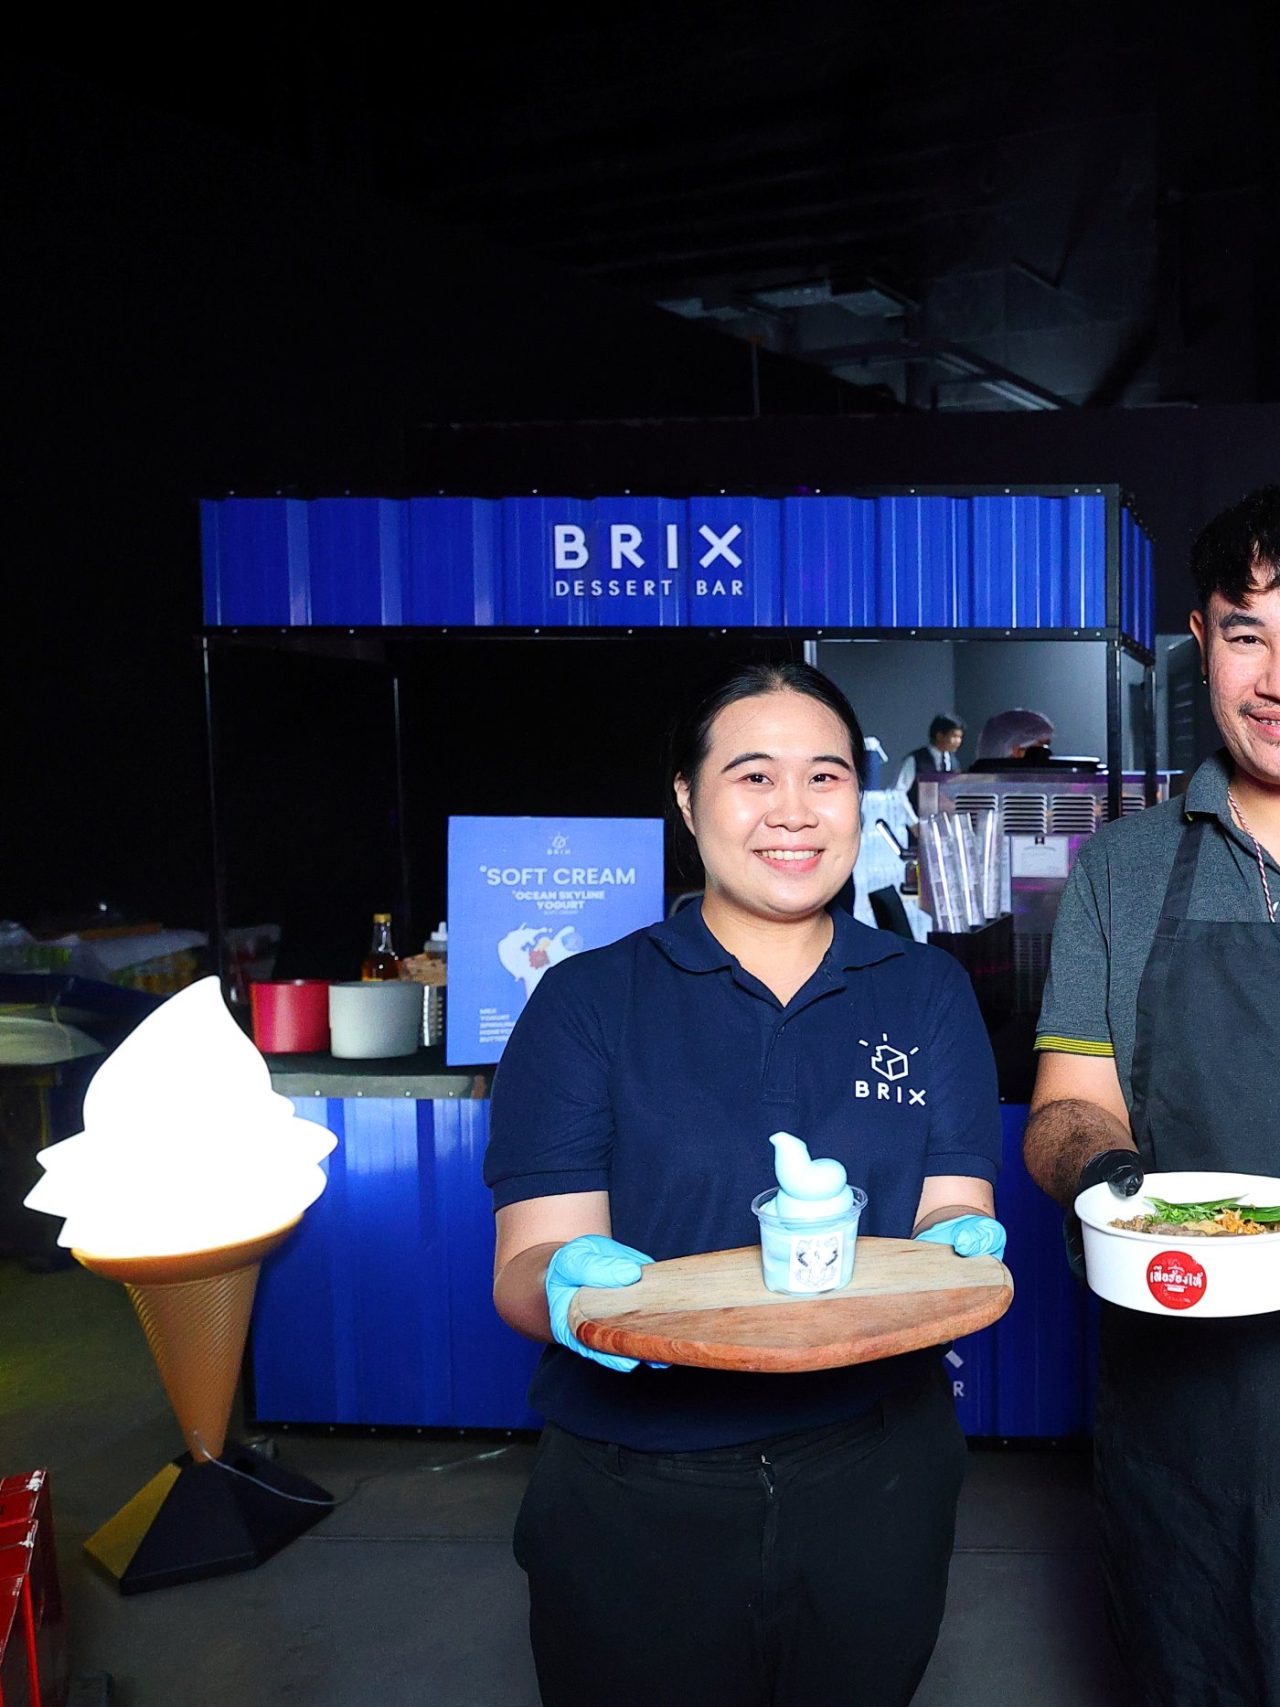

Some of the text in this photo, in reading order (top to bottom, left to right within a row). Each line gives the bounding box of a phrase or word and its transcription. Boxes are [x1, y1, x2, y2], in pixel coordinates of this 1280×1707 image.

[554, 524, 743, 570] BRIX
[555, 580, 744, 596] DESSERT BAR
[553, 867, 636, 886] CREAM
[559, 890, 606, 900] SKYLINE
[536, 900, 585, 910] YOGURT
[855, 1080, 926, 1106] BRIX
